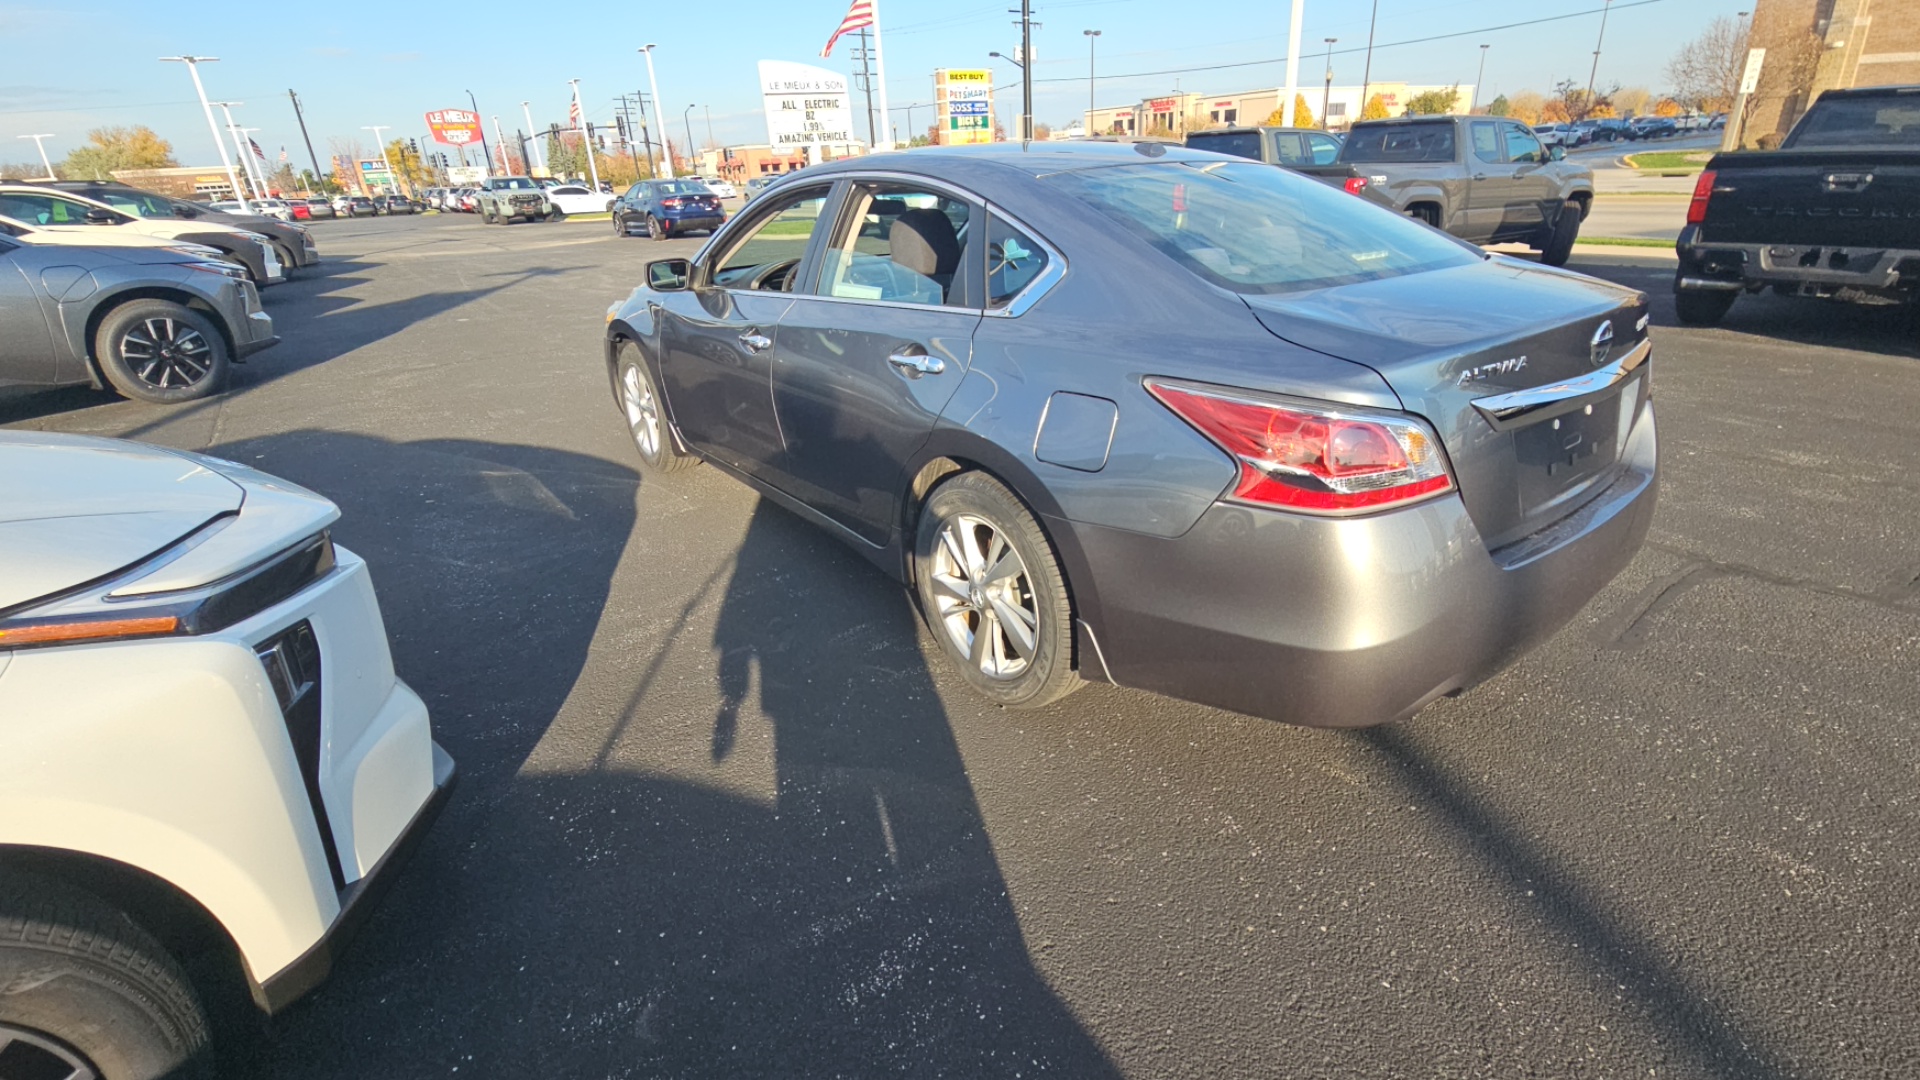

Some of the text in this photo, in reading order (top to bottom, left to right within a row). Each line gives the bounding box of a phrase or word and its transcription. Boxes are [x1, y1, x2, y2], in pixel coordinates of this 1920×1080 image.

[769, 82, 780, 90] LE
[784, 81, 810, 90] MIEUX
[824, 81, 843, 90] SON
[782, 99, 839, 110] ALL ELECTRIC
[429, 110, 476, 123] LE MIEUX
[779, 132, 848, 144] AMAZING VEHICLE
